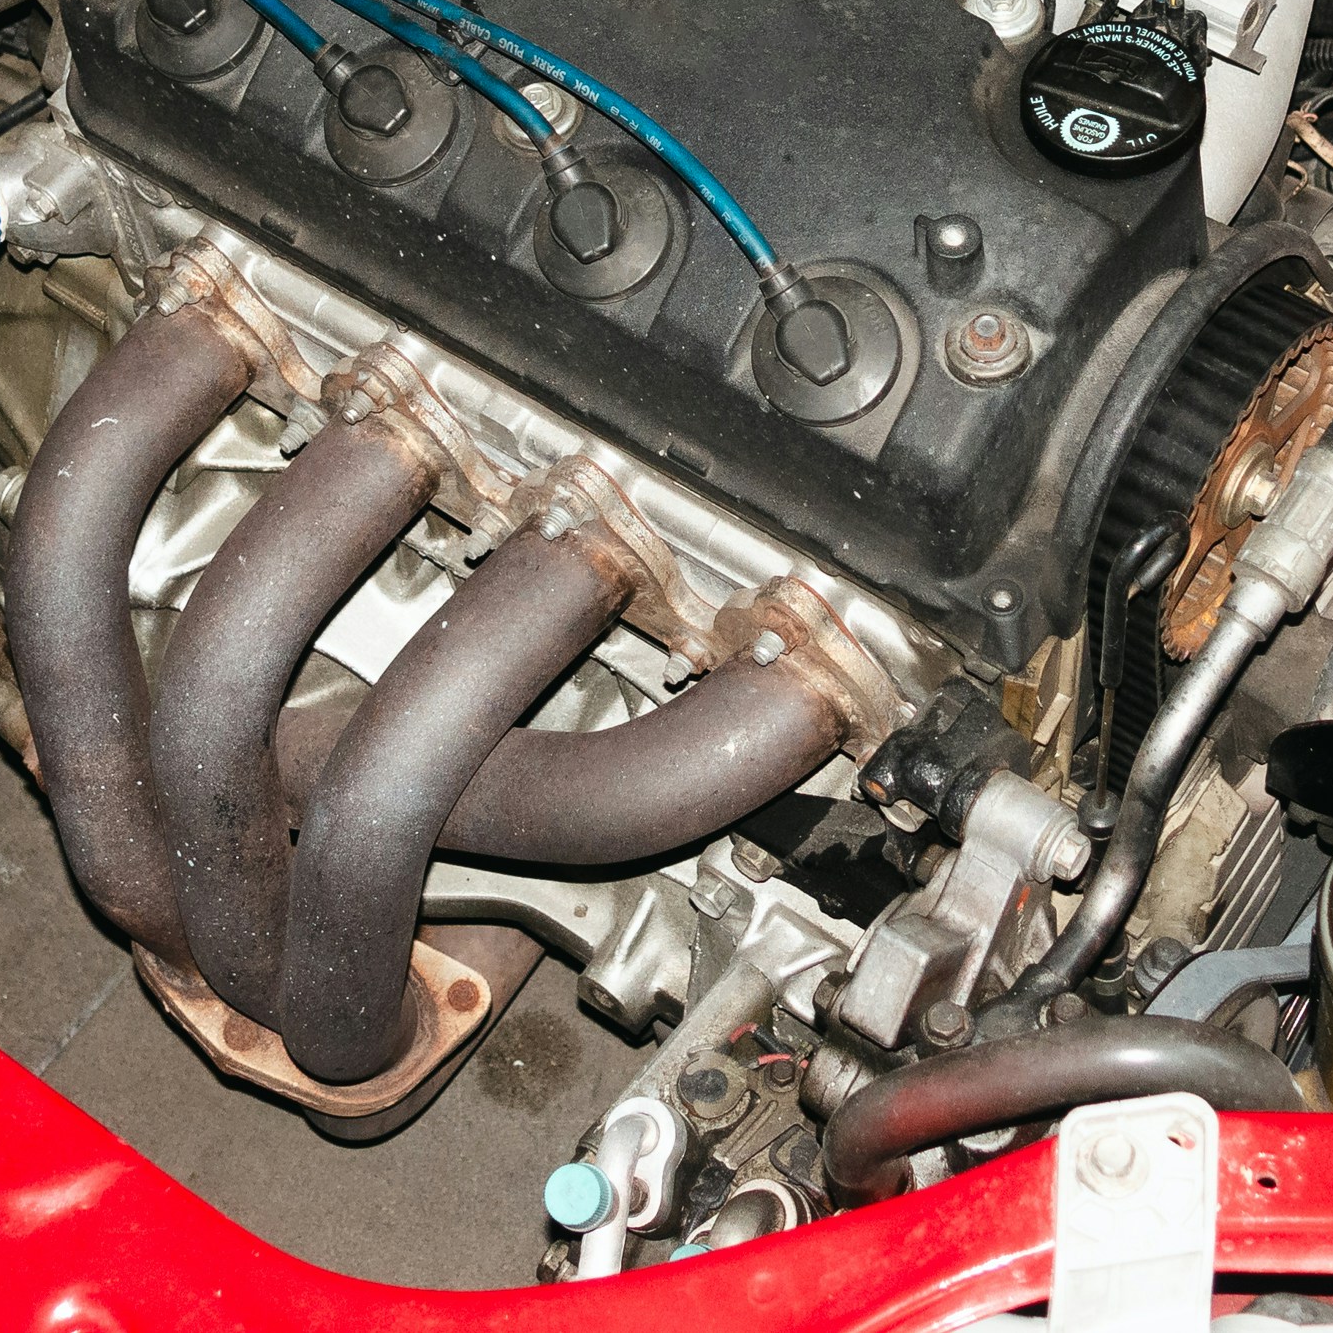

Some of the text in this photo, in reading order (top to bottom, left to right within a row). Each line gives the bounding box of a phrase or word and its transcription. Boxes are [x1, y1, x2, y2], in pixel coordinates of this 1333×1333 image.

[459, 18, 491, 41] CABLE
[1136, 26, 1178, 52] MANUEL
[498, 37, 526, 59] PLUG
[1125, 35, 1172, 61] OWNER'S
[1174, 49, 1188, 62] LE
[532, 54, 567, 82] SPARK
[1182, 61, 1197, 82] VOIR
[573, 78, 601, 104] NGK
[1029, 95, 1059, 130] HUILE
[1071, 123, 1107, 139] GASOLINE
[1077, 116, 1108, 132] ENGINES
[1076, 133, 1094, 144] FOR
